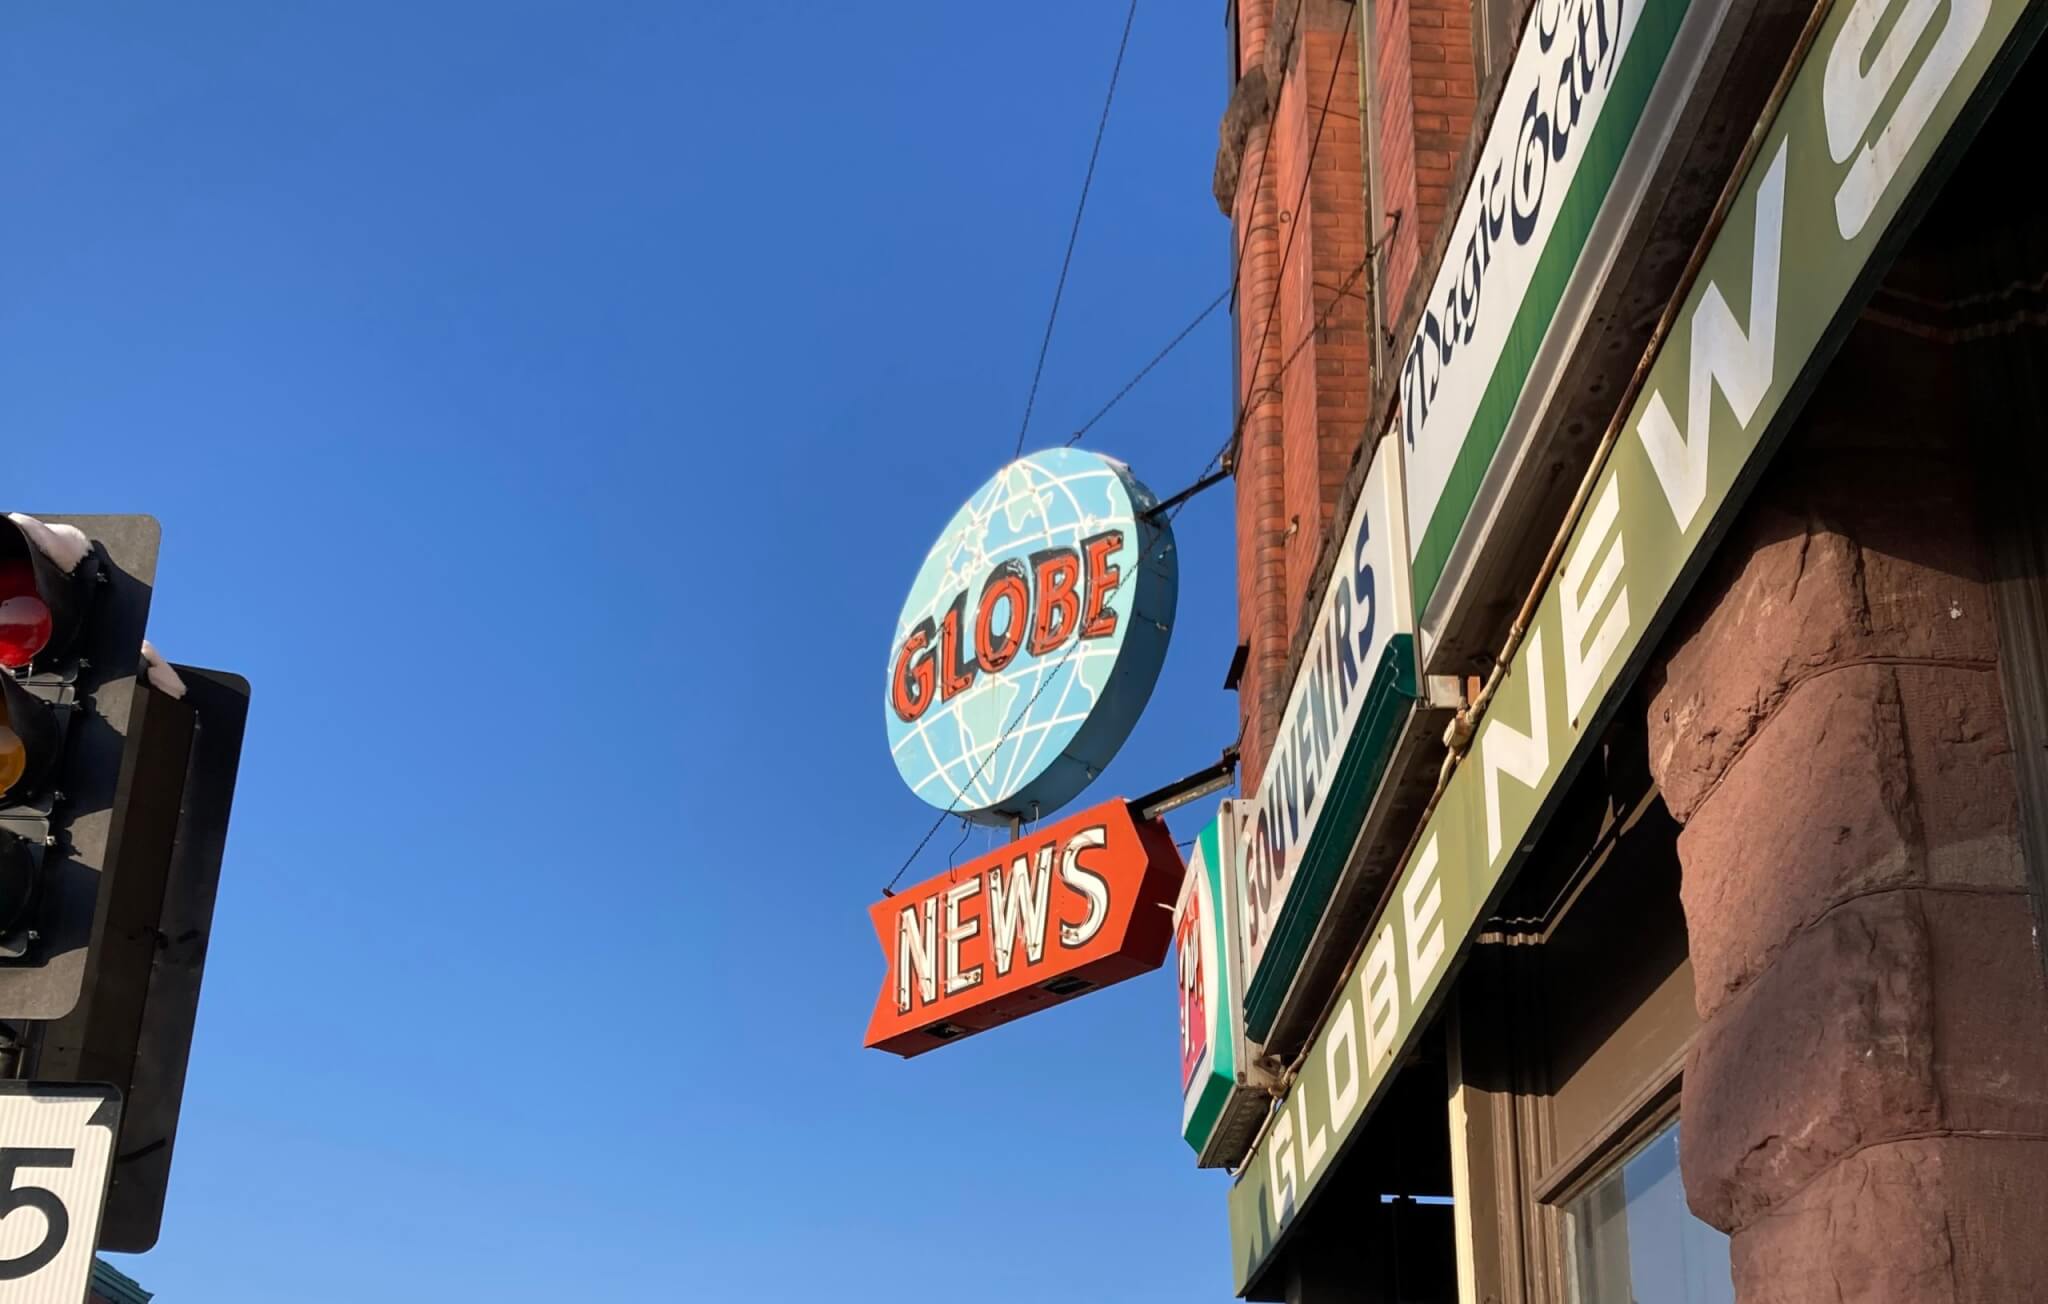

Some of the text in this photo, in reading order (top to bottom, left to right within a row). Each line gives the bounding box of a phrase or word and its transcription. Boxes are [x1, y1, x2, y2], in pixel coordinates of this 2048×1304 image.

[1404, 157, 1506, 453] Magic
[887, 530, 1124, 723] GLOBE
[1245, 510, 1376, 946] SOUVENIRS
[1268, 0, 1994, 1225] GLOBE NEWS
[892, 824, 1109, 1017] NEWS
